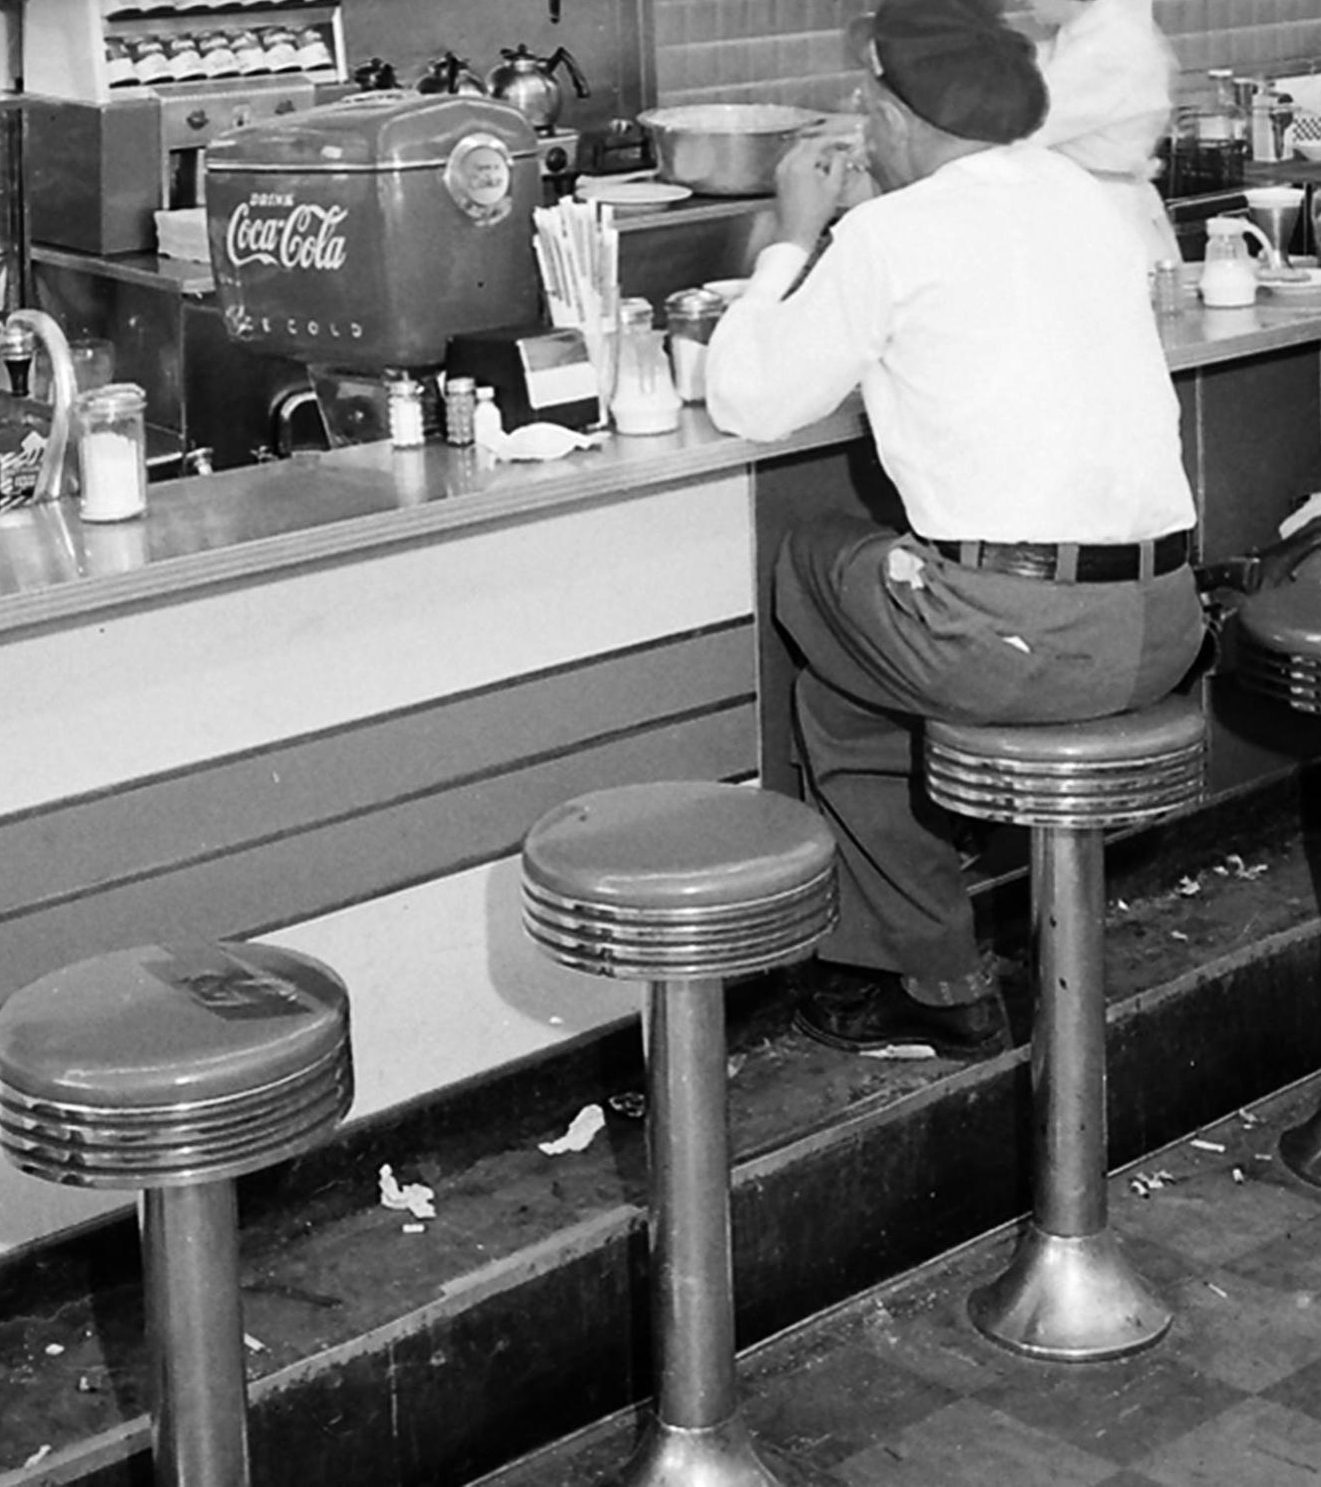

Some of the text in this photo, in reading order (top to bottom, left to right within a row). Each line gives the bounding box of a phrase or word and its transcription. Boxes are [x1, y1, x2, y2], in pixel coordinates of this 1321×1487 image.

[249, 192, 294, 207] DRINK
[227, 202, 349, 271] Coca-Cola
[287, 318, 363, 338] COLD
